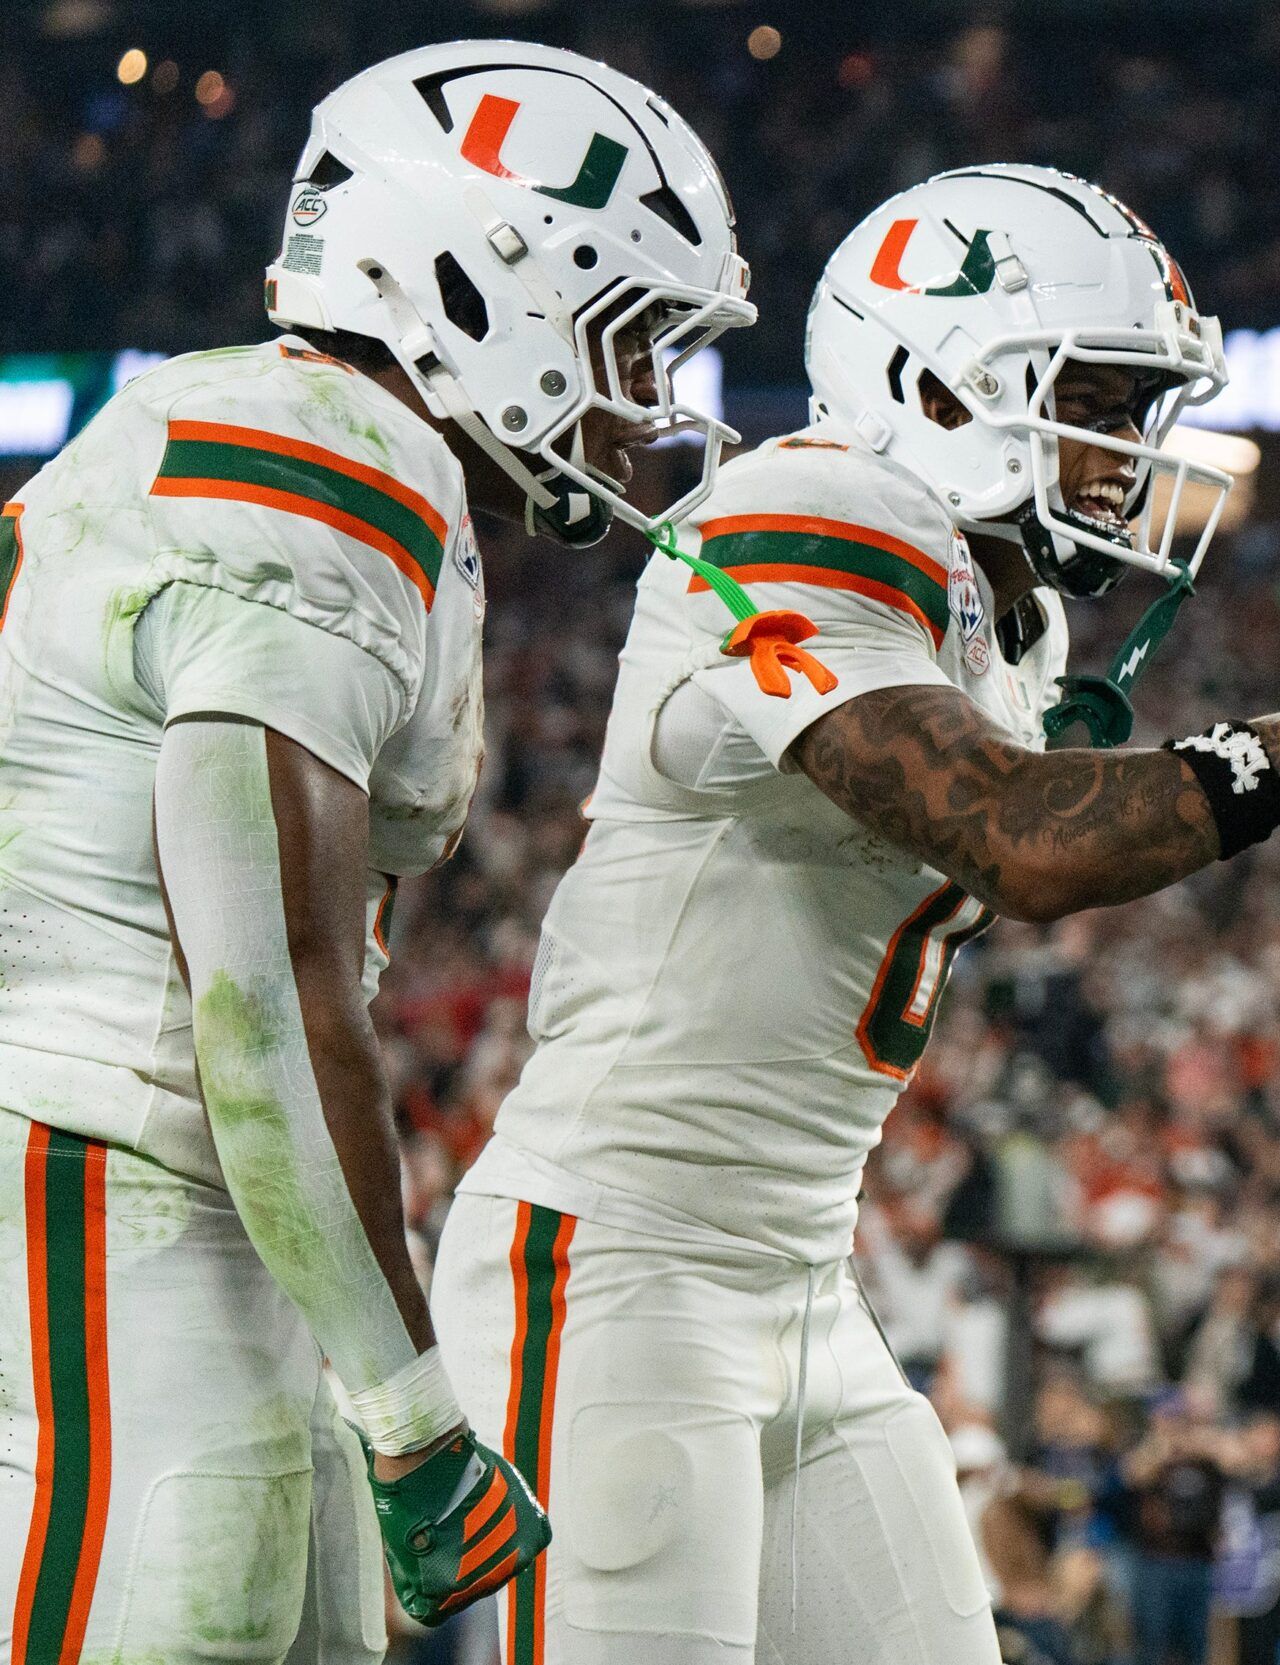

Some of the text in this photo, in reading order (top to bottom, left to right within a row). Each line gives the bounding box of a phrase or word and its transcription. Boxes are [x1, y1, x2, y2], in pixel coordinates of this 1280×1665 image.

[461, 94, 629, 209] U
[295, 198, 322, 212] ACC
[870, 219, 997, 297] U
[969, 645, 986, 664] ACC
